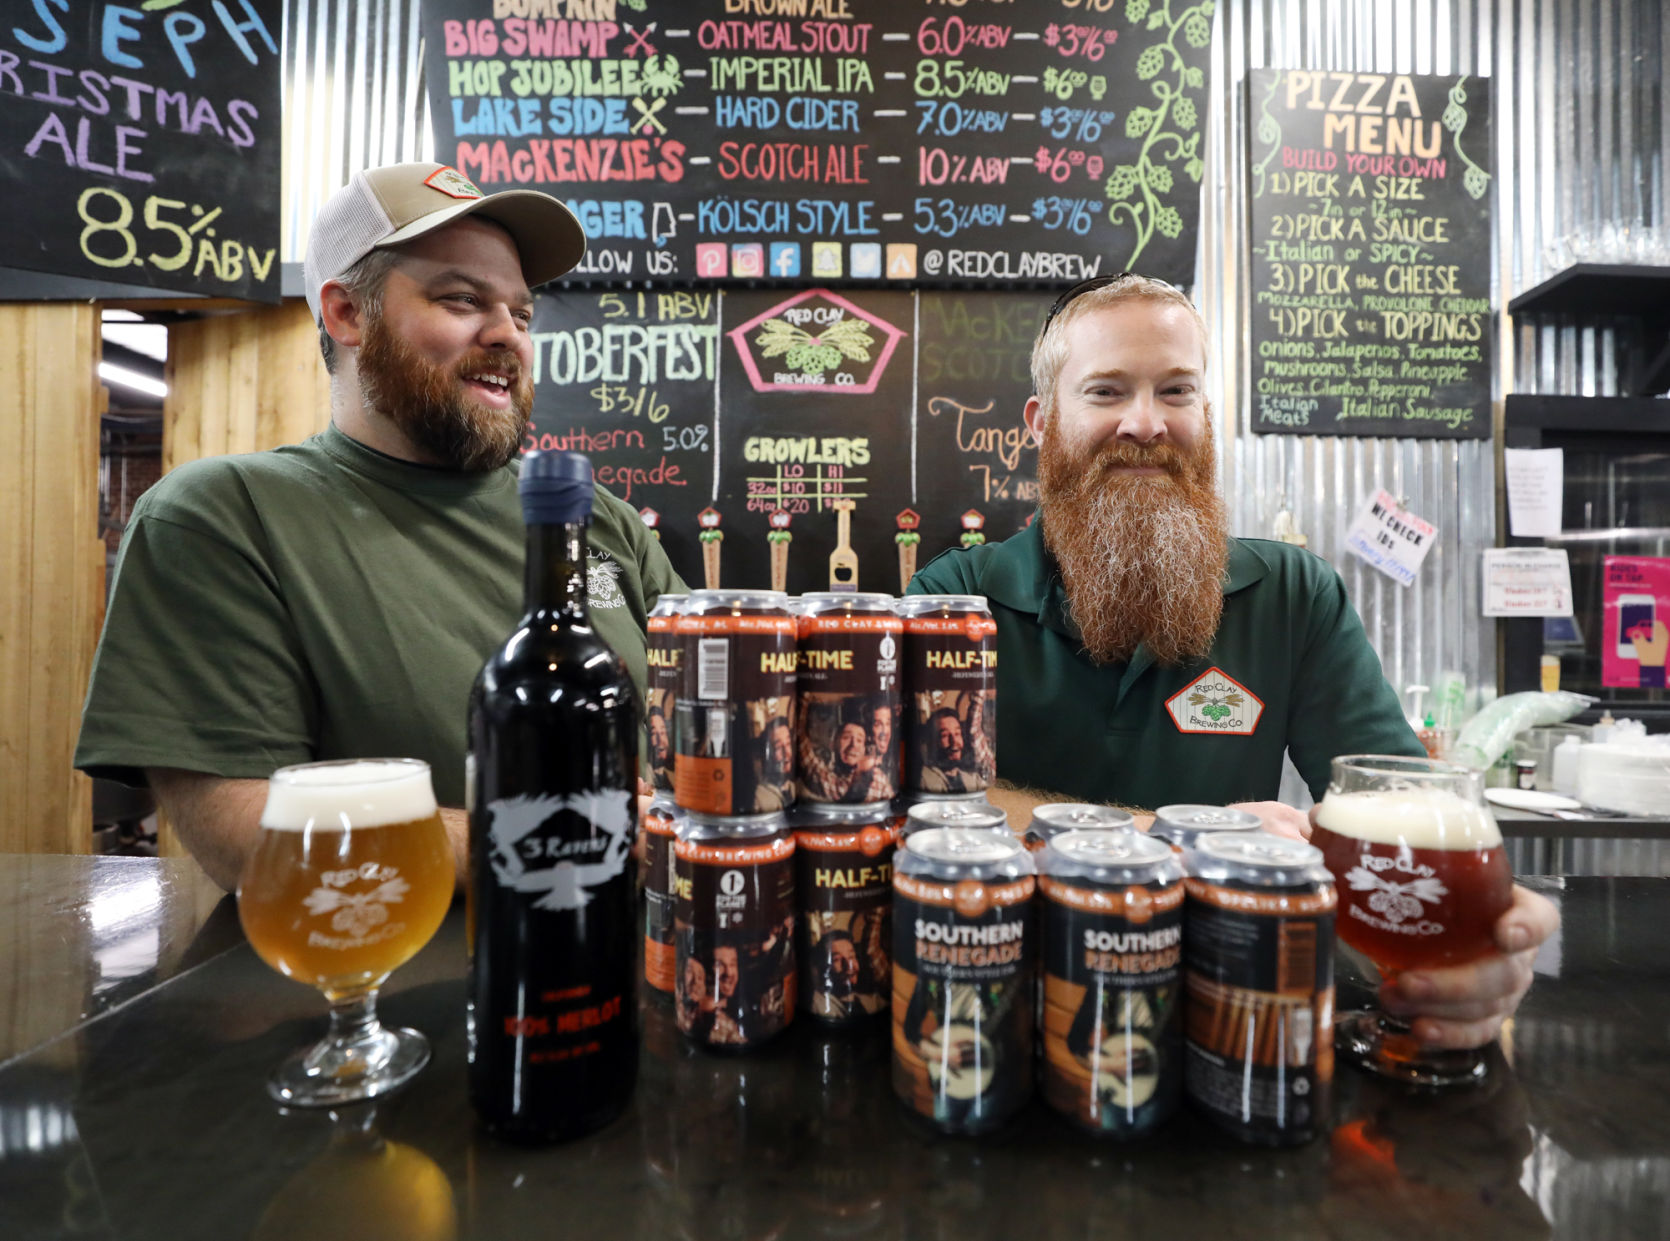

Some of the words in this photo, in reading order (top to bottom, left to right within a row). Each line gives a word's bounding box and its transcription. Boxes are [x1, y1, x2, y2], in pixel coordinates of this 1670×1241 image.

[443, 19, 499, 56] BIG
[502, 17, 620, 58] SWAMP
[697, 19, 799, 51] OATMEAL
[801, 20, 873, 54] STOUT
[449, 59, 507, 96] HOP
[510, 58, 641, 96] JUBILEE
[709, 56, 832, 93] IMPERIAL
[836, 58, 875, 94] IPA
[1285, 70, 1422, 118] PIZZA
[451, 97, 543, 137] LAKE
[549, 97, 629, 136] SIDE
[716, 95, 780, 129] HARD
[785, 97, 860, 133] CIDER
[25, 112, 156, 183] ALE
[1323, 113, 1442, 159] MENU
[718, 141, 819, 182] SCOTCH
[824, 144, 869, 183] ALE
[1283, 146, 1338, 171] BUILD
[1345, 153, 1398, 176] YOUR
[1399, 158, 1446, 178] OWN
[1294, 172, 1340, 198] PICK
[1348, 175, 1366, 198] A
[1373, 176, 1425, 200] SIZE
[698, 195, 789, 235] KÖLSCH
[796, 200, 880, 235] STYLE
[1349, 205, 1365, 216] or
[1297, 215, 1345, 241] PICK
[1347, 218, 1366, 242] A
[1373, 217, 1449, 243] SAUCE
[194, 239, 276, 282] ABV
[646, 251, 678, 275] US:
[1345, 249, 1362, 262] or
[1299, 262, 1351, 295] PICK
[1355, 273, 1379, 290] the
[1384, 265, 1462, 295] CHEESE
[599, 292, 645, 318] 5.1
[658, 292, 711, 321] ABV
[784, 308, 812, 325] RED
[813, 307, 845, 325] CLAY
[1297, 307, 1349, 338] PICK
[1355, 319, 1377, 333] the
[1380, 311, 1482, 341] TOPPINGS
[774, 373, 825, 385] BREWING
[1342, 397, 1400, 417] Italian
[1402, 398, 1474, 429] Sausage
[744, 436, 871, 467] GROWLERS
[784, 464, 804, 478] LO
[969, 464, 1009, 502] 7%
[782, 481, 805, 495] $10
[782, 498, 810, 514] $20
[1195, 684, 1213, 693] RED
[1215, 683, 1237, 693] CLAY
[1189, 715, 1228, 729] BREWING
[1360, 854, 1395, 872] RED
[915, 918, 1024, 946] SOUTHERN
[1084, 923, 1181, 953] SOUTHERN
[915, 939, 1023, 967] RENEGADE
[556, 994, 622, 1034] MERLOT
